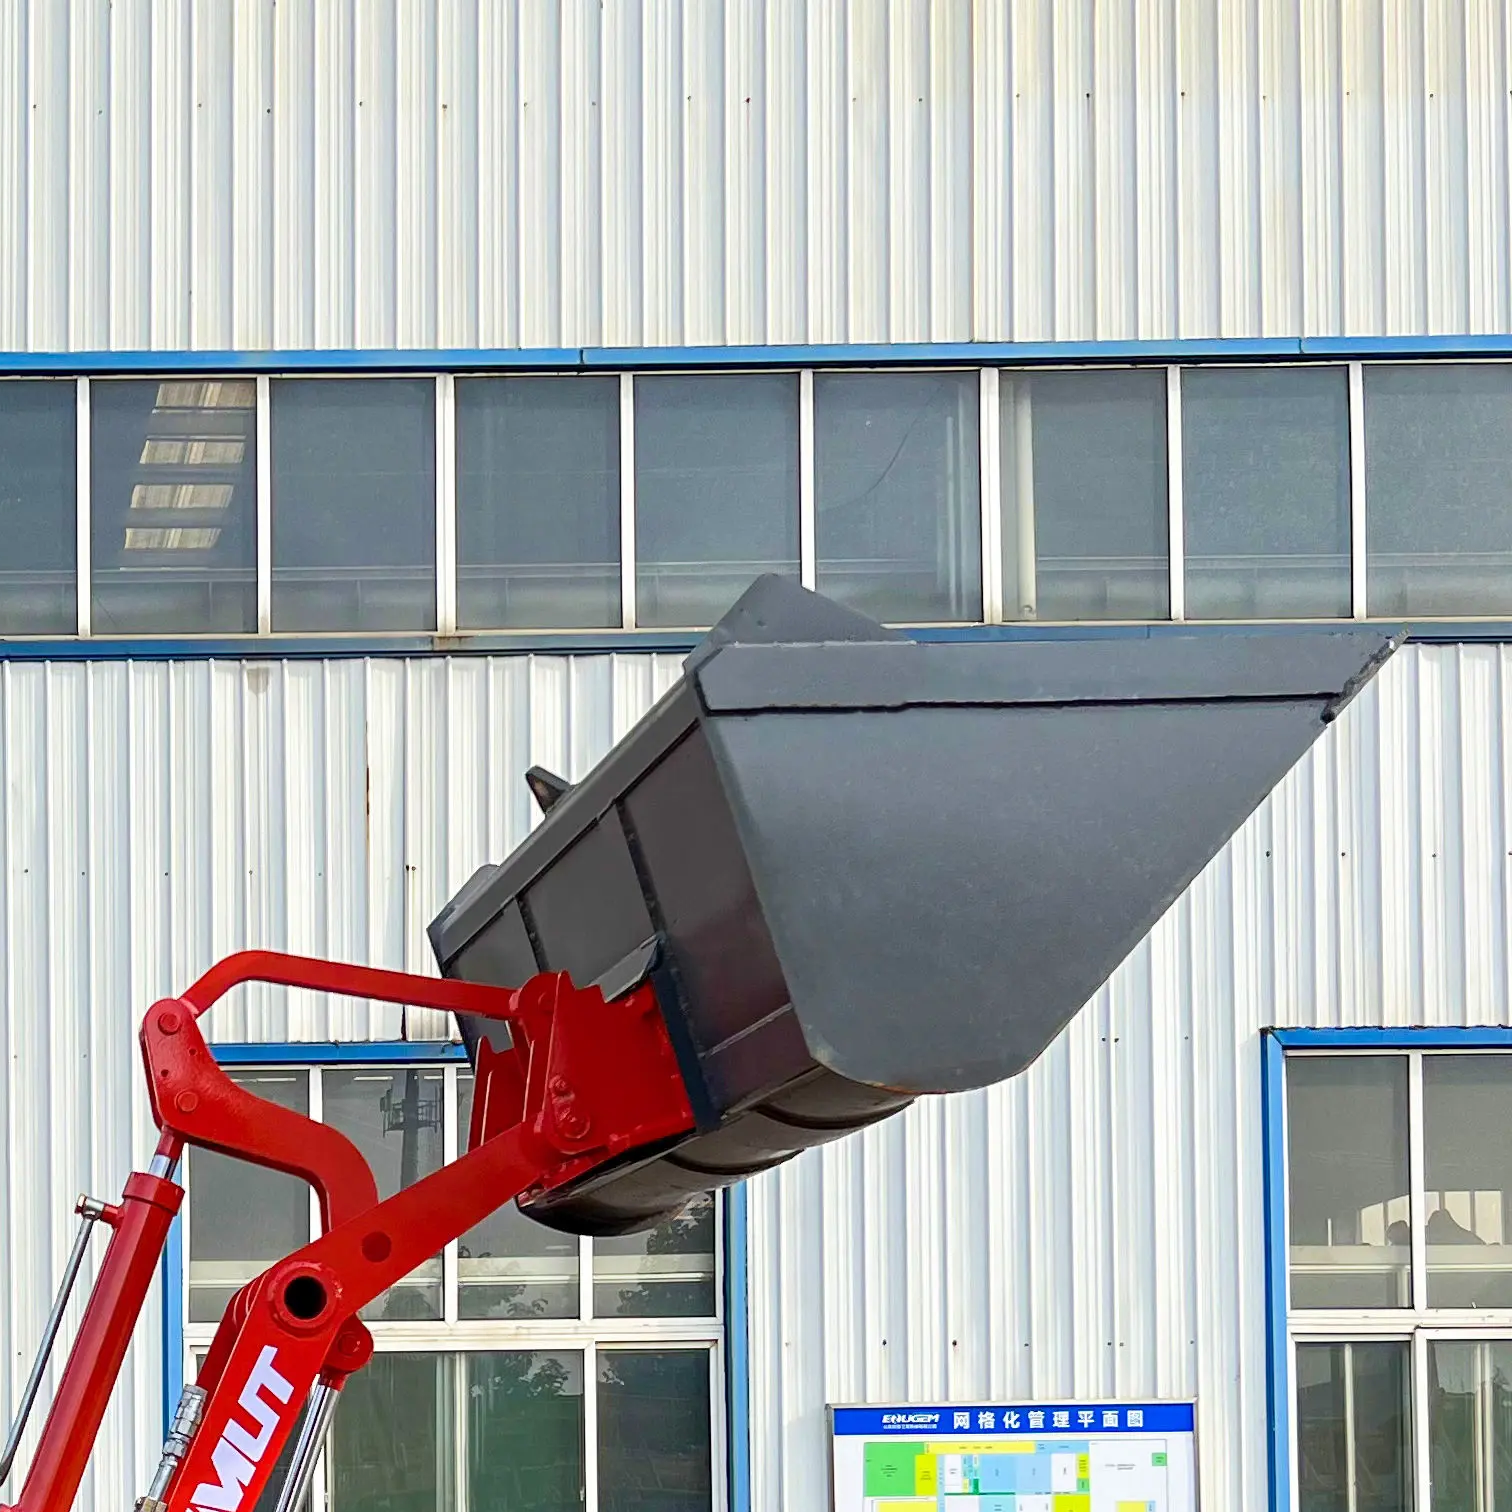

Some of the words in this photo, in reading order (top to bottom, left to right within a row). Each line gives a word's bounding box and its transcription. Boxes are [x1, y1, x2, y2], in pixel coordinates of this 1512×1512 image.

[953, 1410, 1144, 1429] 网格化管理平面图
